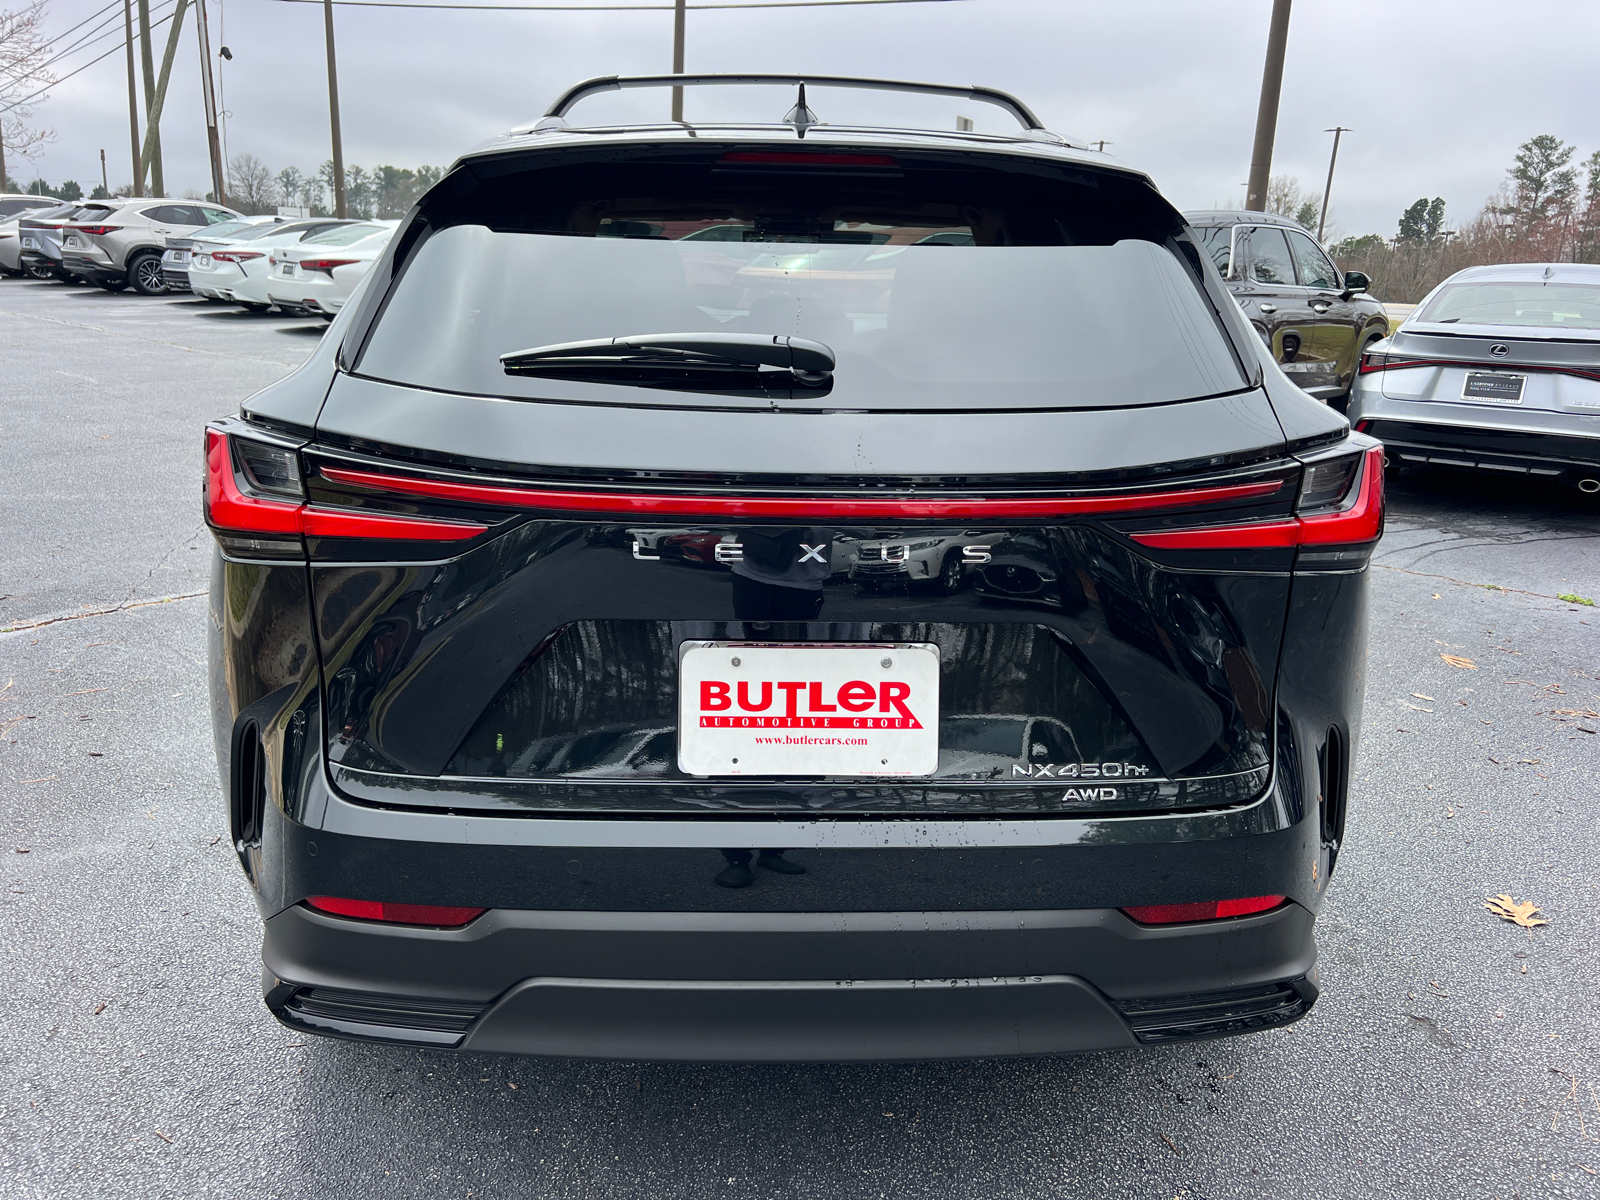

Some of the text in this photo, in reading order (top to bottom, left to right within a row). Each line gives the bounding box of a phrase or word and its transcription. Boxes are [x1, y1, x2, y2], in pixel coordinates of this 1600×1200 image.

[632, 541, 992, 564] LEXUS
[700, 717, 916, 728] AUTOMOTIVE GROUP
[755, 735, 868, 746] www.butlercars.com
[1062, 788, 1118, 801] AWD
